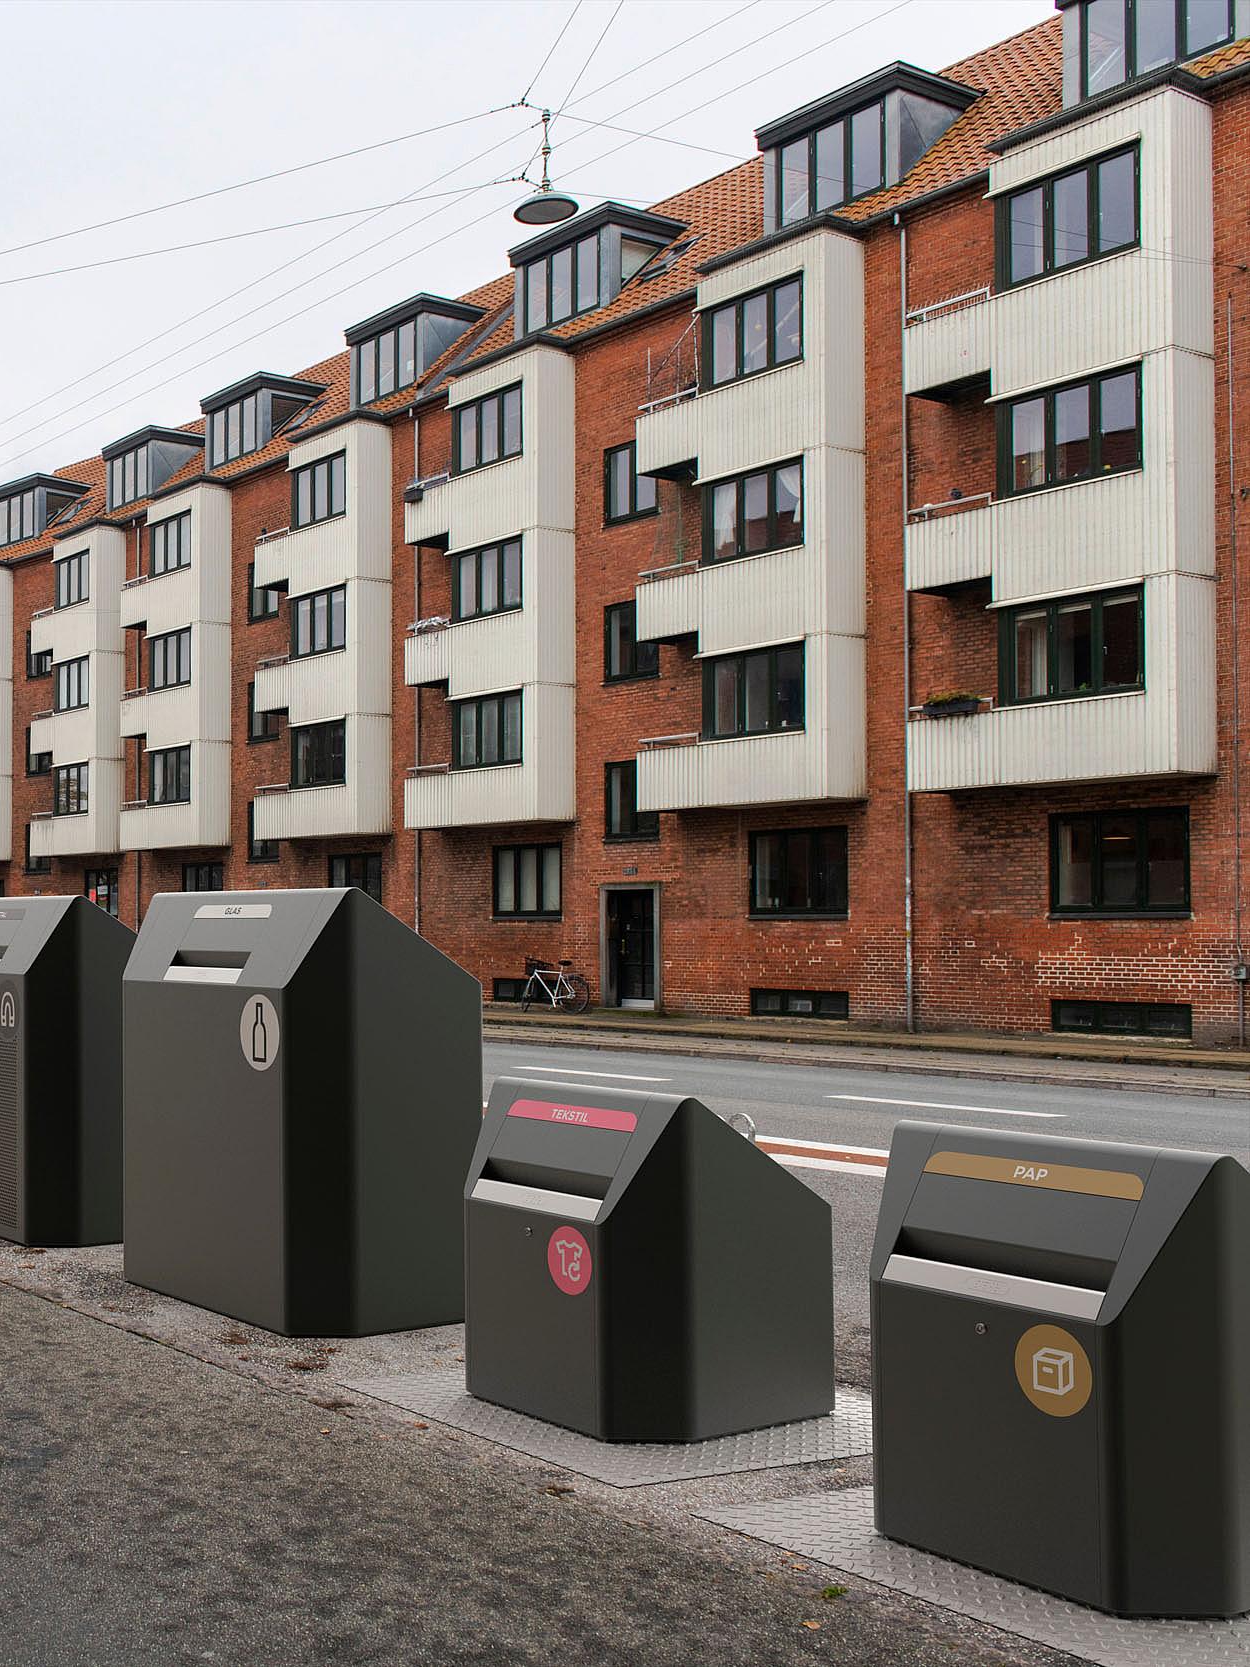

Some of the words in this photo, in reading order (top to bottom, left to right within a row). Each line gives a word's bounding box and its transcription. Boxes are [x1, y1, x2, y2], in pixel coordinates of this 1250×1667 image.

[224, 907, 243, 915] GLAS
[551, 1108, 589, 1123] TEKSTIL
[1013, 1165, 1048, 1181] PAP
